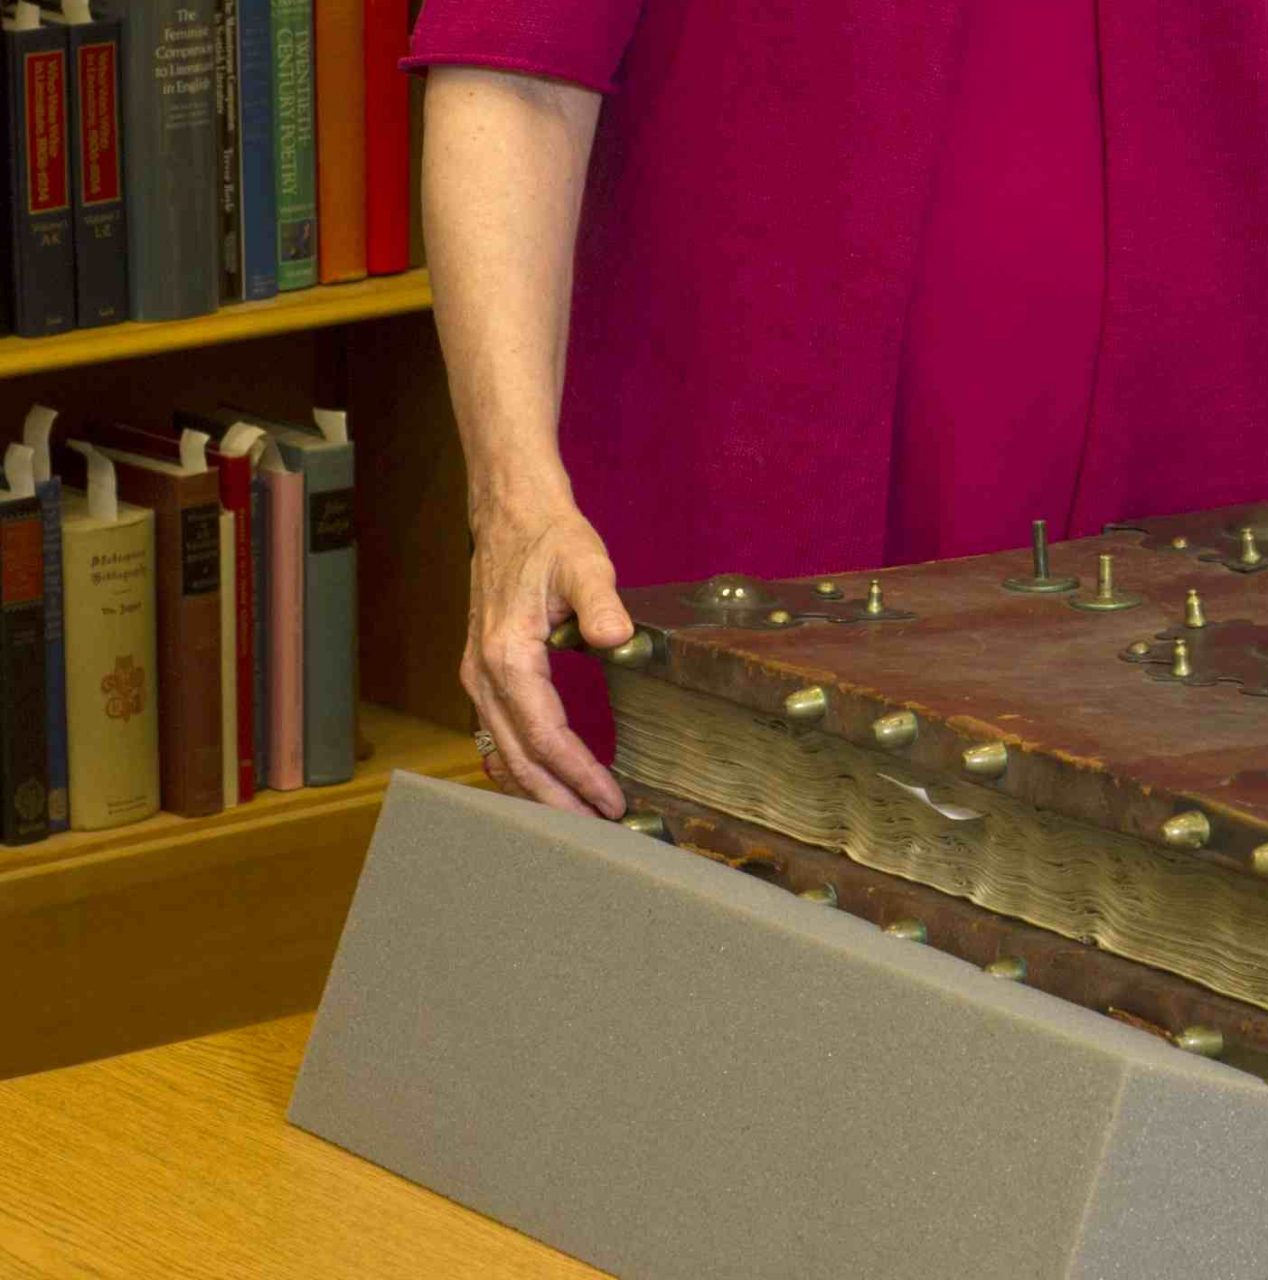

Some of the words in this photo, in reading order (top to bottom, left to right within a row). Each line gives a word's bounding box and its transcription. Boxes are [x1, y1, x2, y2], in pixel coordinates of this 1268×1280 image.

[176, 9, 196, 23] The
[155, 67, 168, 79] to
[276, 27, 296, 119] CENTURY
[163, 83, 175, 95] in
[280, 122, 298, 196] POETRY
